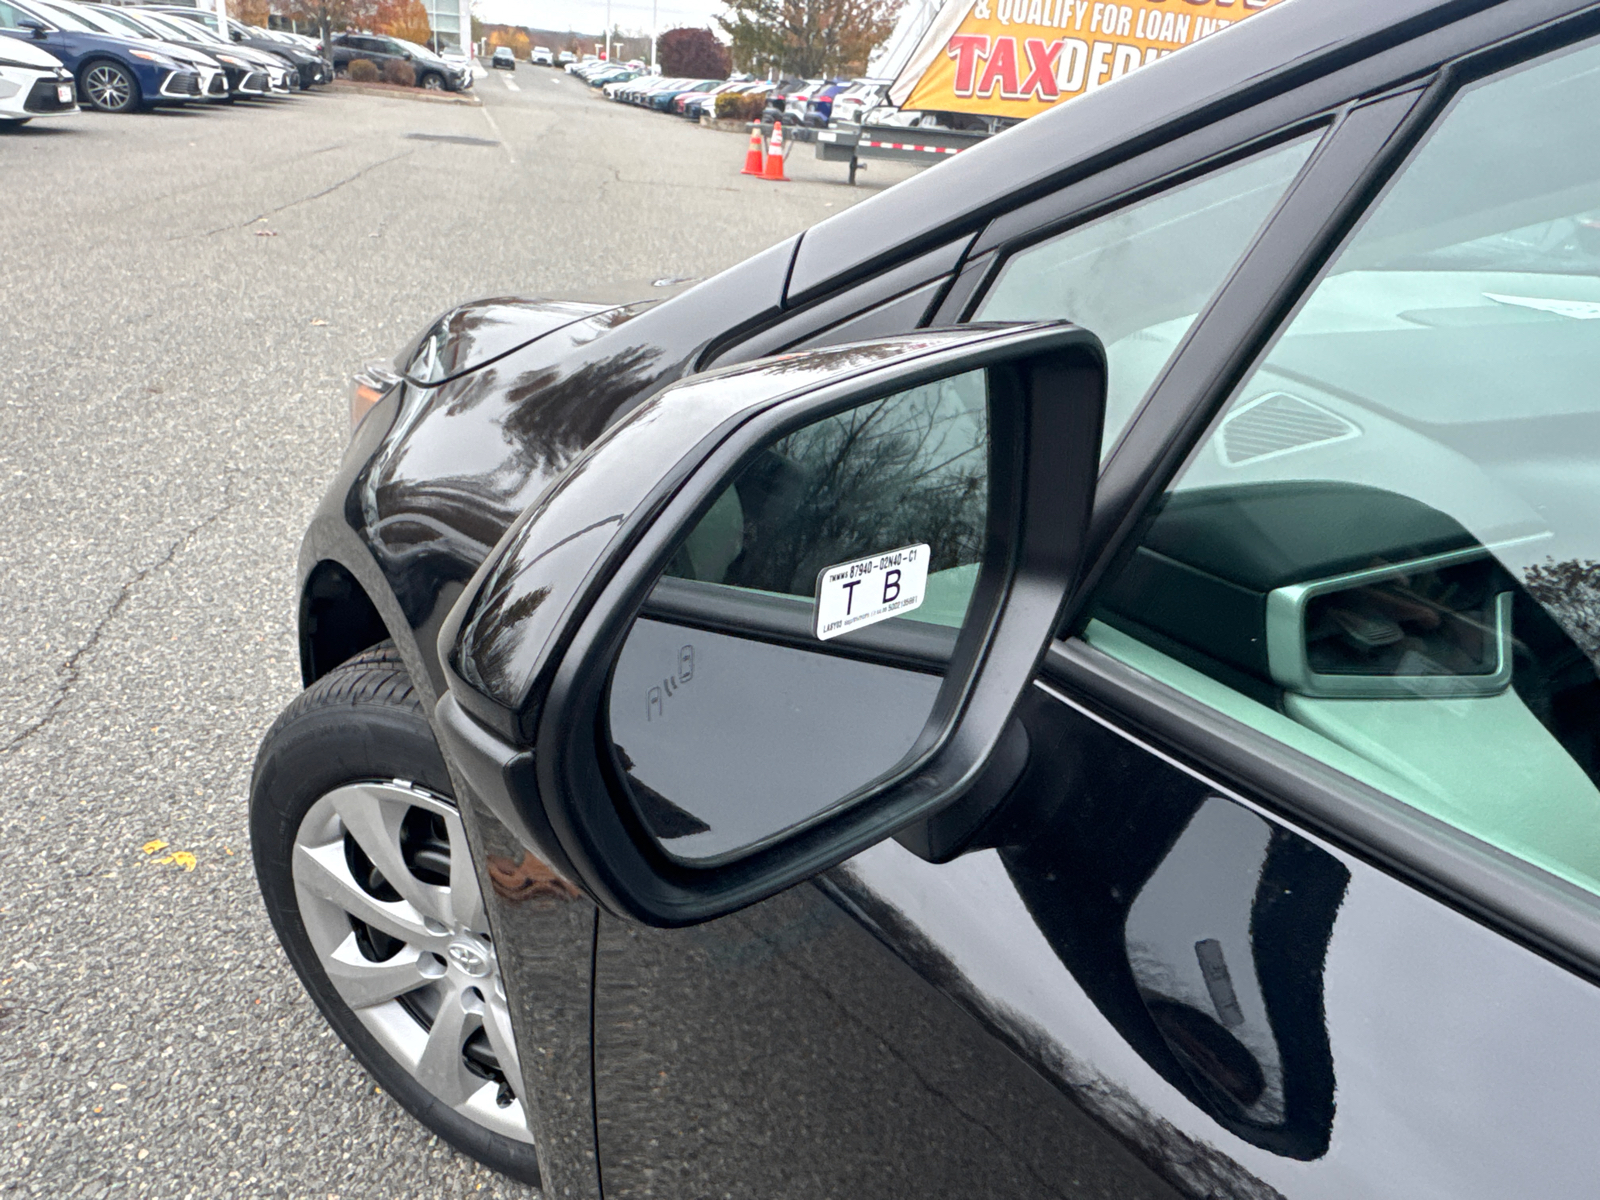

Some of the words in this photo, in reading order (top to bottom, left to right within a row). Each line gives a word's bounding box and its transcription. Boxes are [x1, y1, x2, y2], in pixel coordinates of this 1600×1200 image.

[974, 0, 991, 20] &
[997, 0, 1088, 31] QUALIFY
[1090, 1, 1132, 37] FOR
[1135, 8, 1190, 44] LOAN
[947, 33, 1066, 102] TAX
[842, 579, 862, 616] T
[882, 569, 902, 604] B
